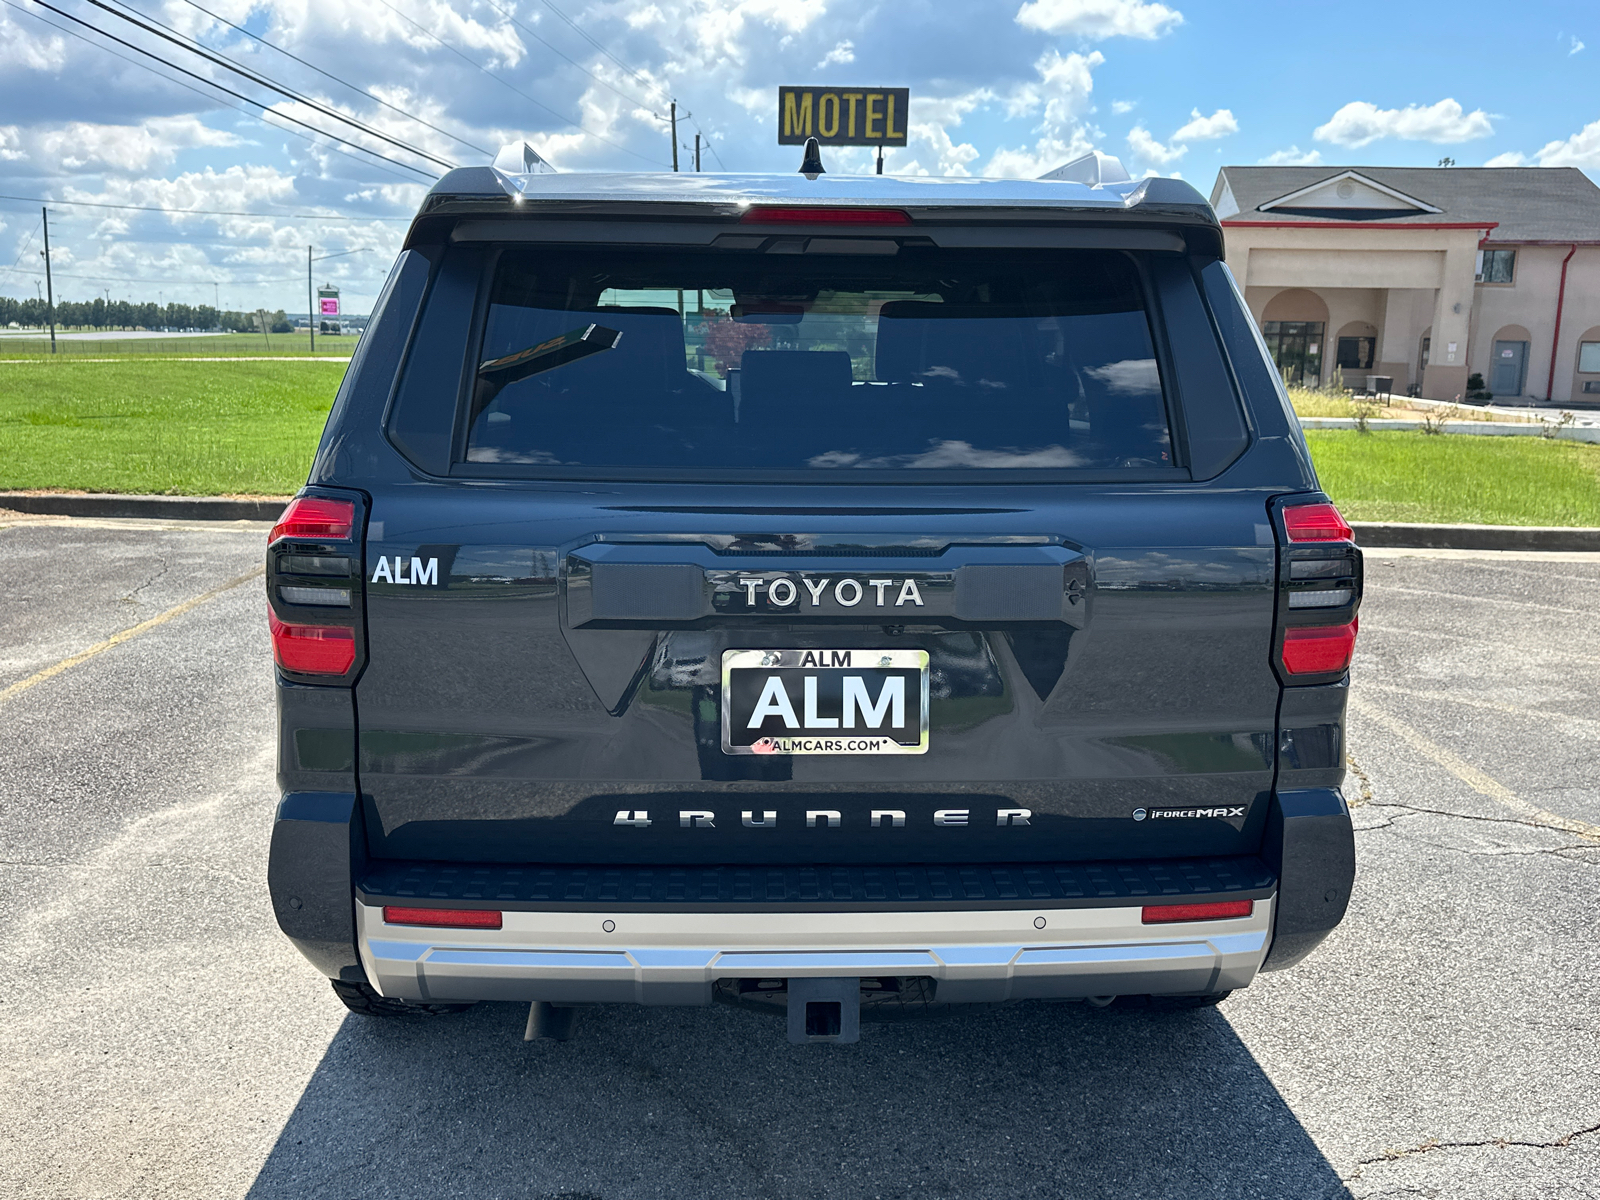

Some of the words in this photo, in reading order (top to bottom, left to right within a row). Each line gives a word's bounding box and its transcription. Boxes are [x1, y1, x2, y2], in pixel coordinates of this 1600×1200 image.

[784, 92, 904, 138] MOTEL
[371, 555, 438, 585] ALM
[739, 578, 924, 607] TOYOTA
[801, 651, 851, 667] ALM
[747, 676, 905, 728] ALM
[772, 740, 880, 751] ALMCARS.COM
